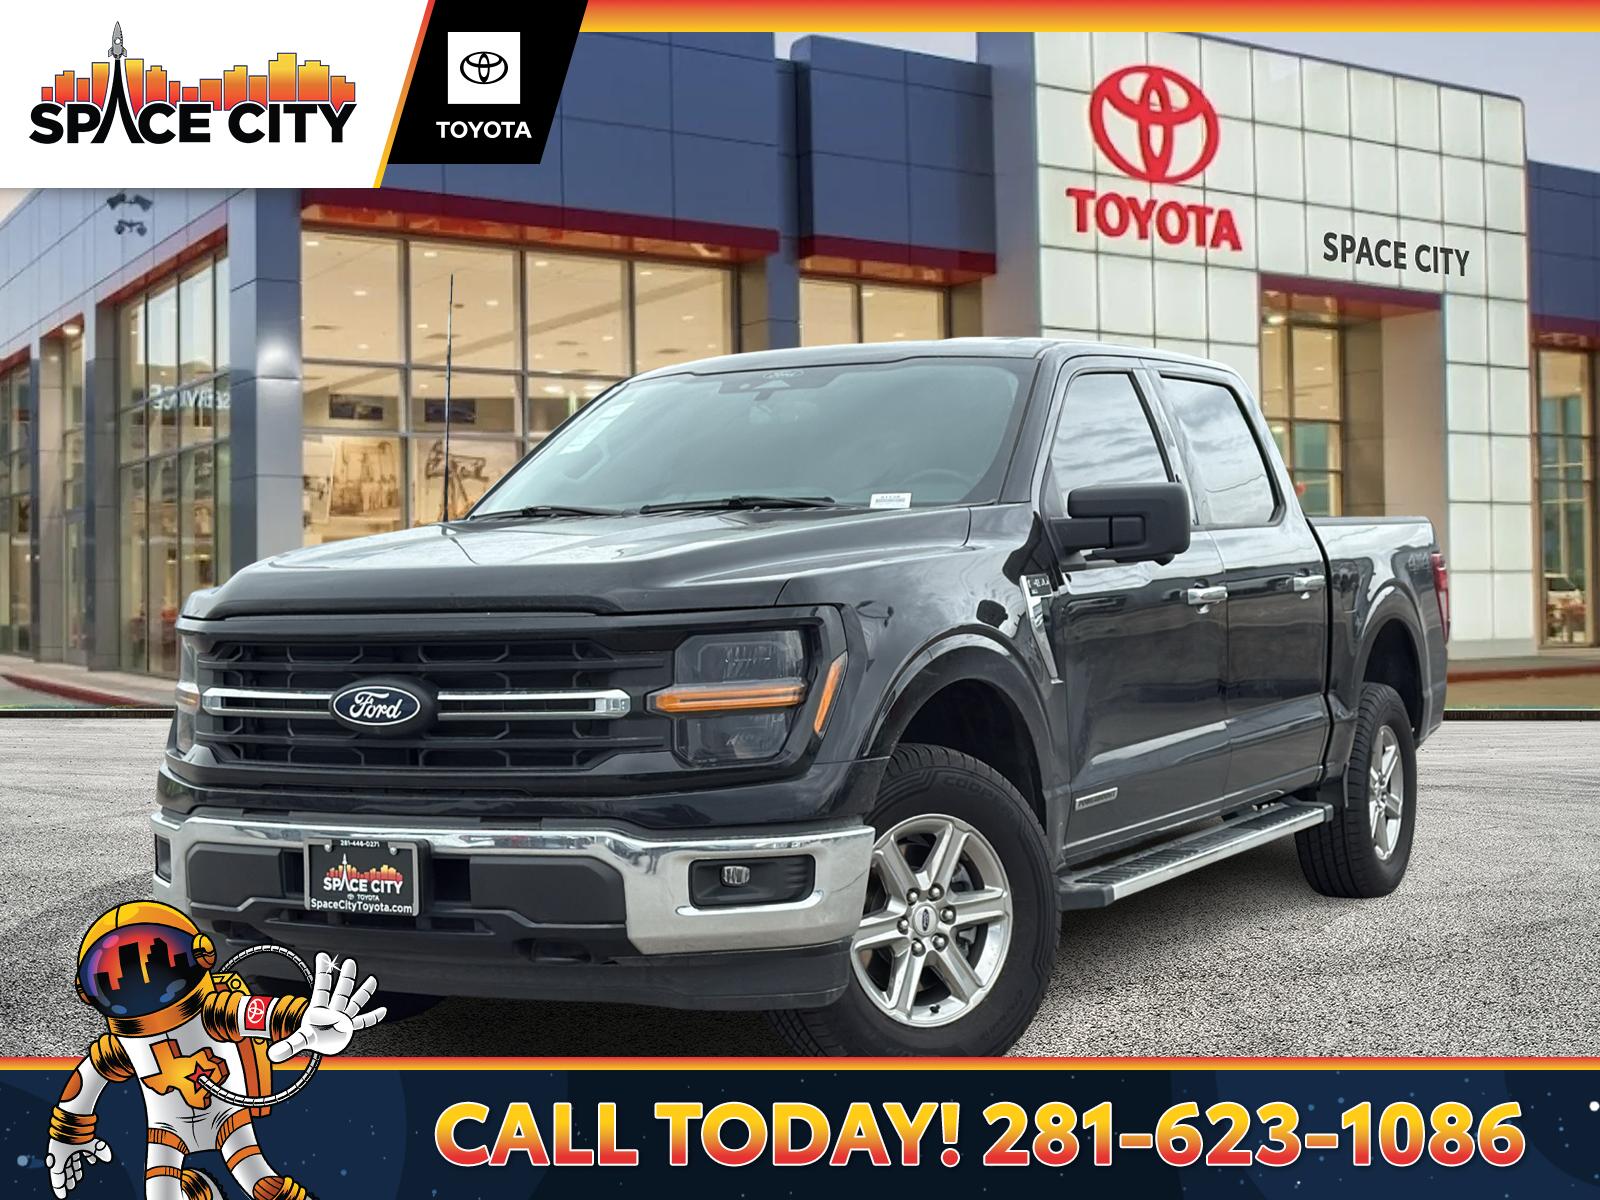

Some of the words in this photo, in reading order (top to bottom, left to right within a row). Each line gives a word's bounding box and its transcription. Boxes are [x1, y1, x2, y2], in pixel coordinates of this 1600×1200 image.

[1066, 187, 1243, 252] TOYOTA
[1322, 231, 1407, 270] SPACE
[1413, 244, 1470, 277] CITY
[349, 691, 403, 719] Ford
[323, 877, 368, 893] SPACE
[371, 879, 403, 895] CITY
[311, 898, 413, 913] SpaceCityToyota.com
